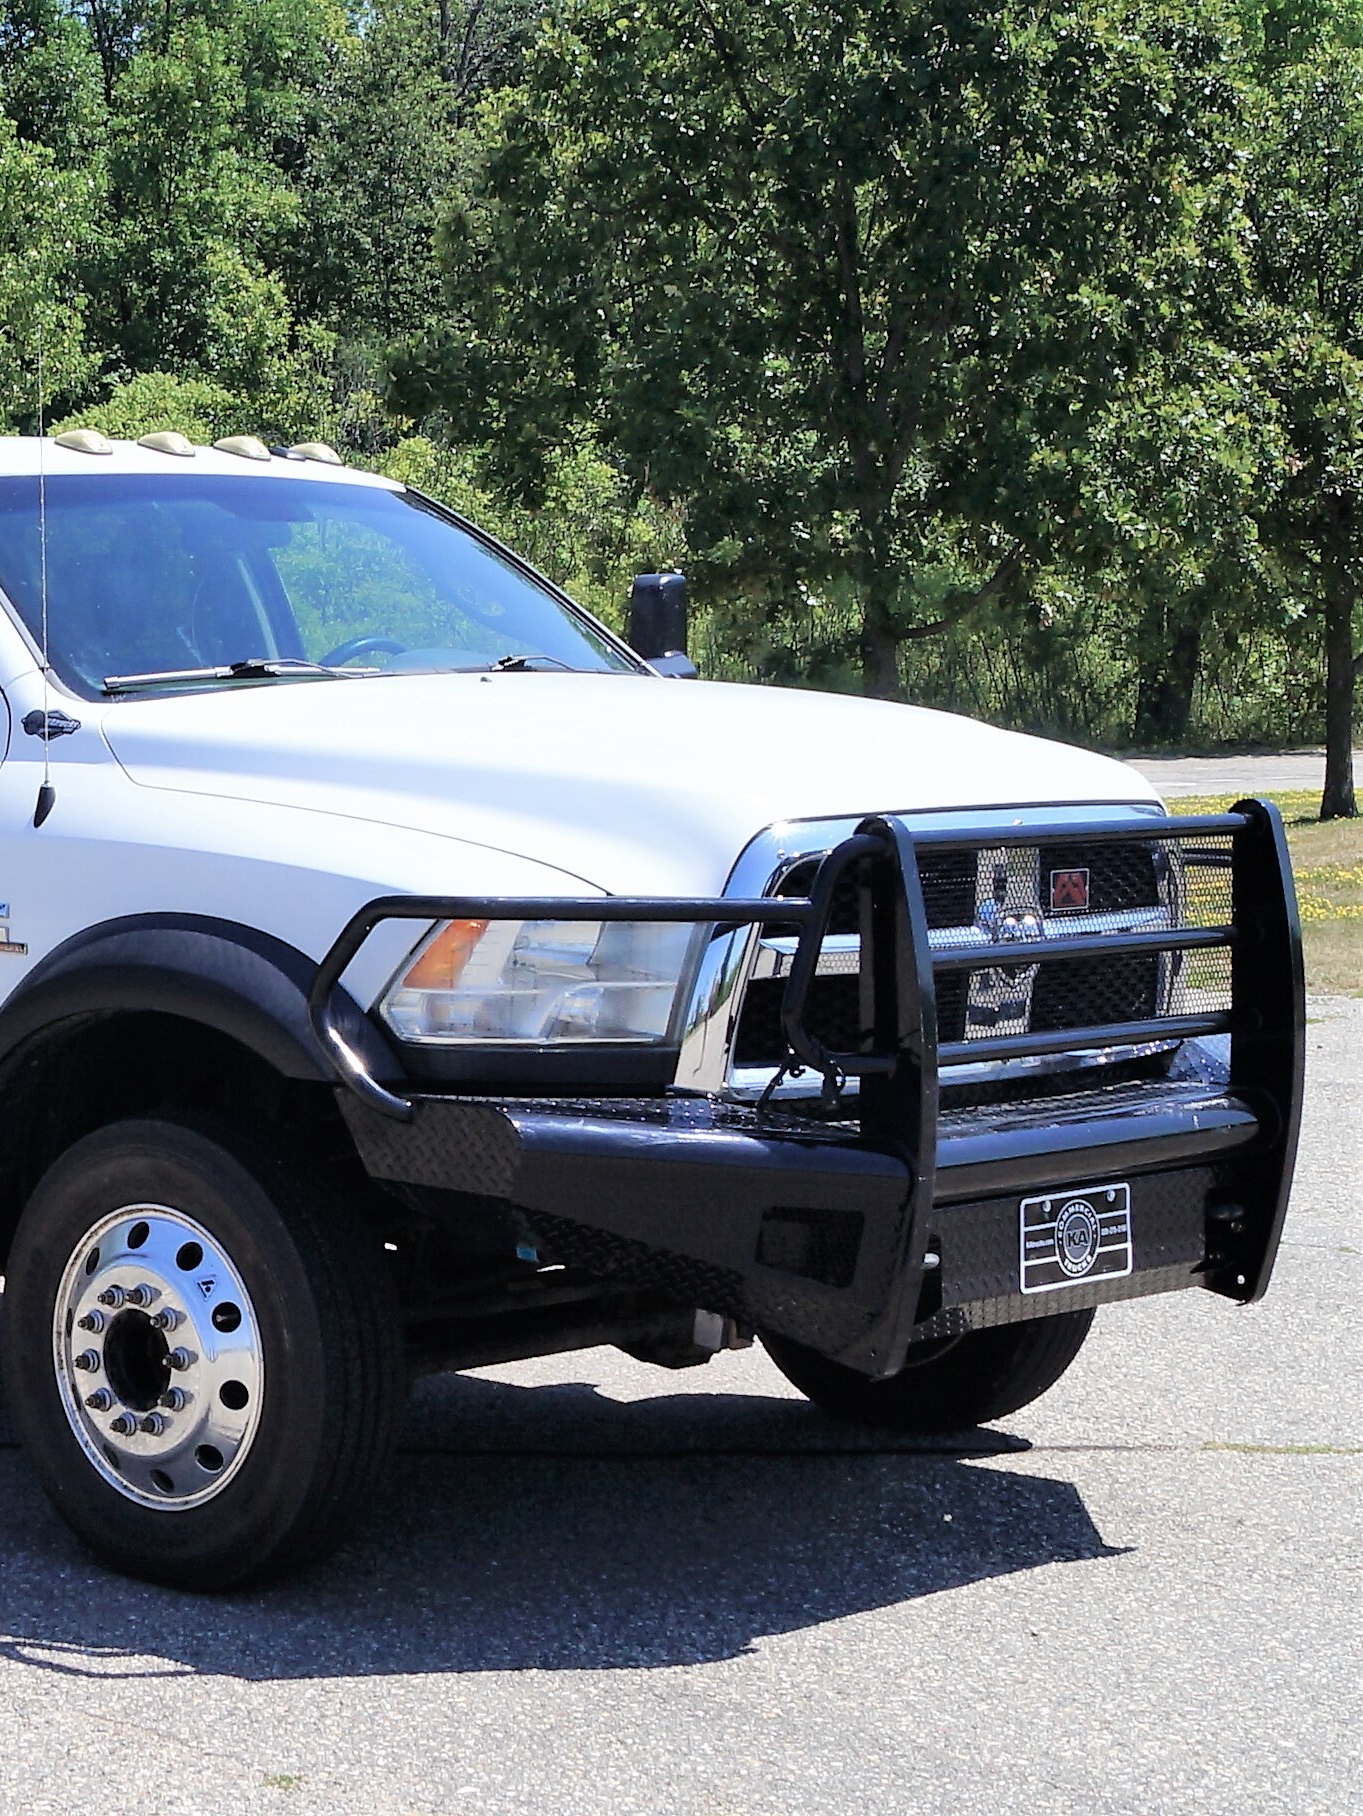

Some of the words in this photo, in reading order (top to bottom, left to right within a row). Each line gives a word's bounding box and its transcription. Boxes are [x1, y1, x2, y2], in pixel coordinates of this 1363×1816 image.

[1057, 1203, 1097, 1238] COMMERCIAL
[1065, 1228, 1089, 1249] KA
[1063, 1254, 1093, 1273] TRUCKS
